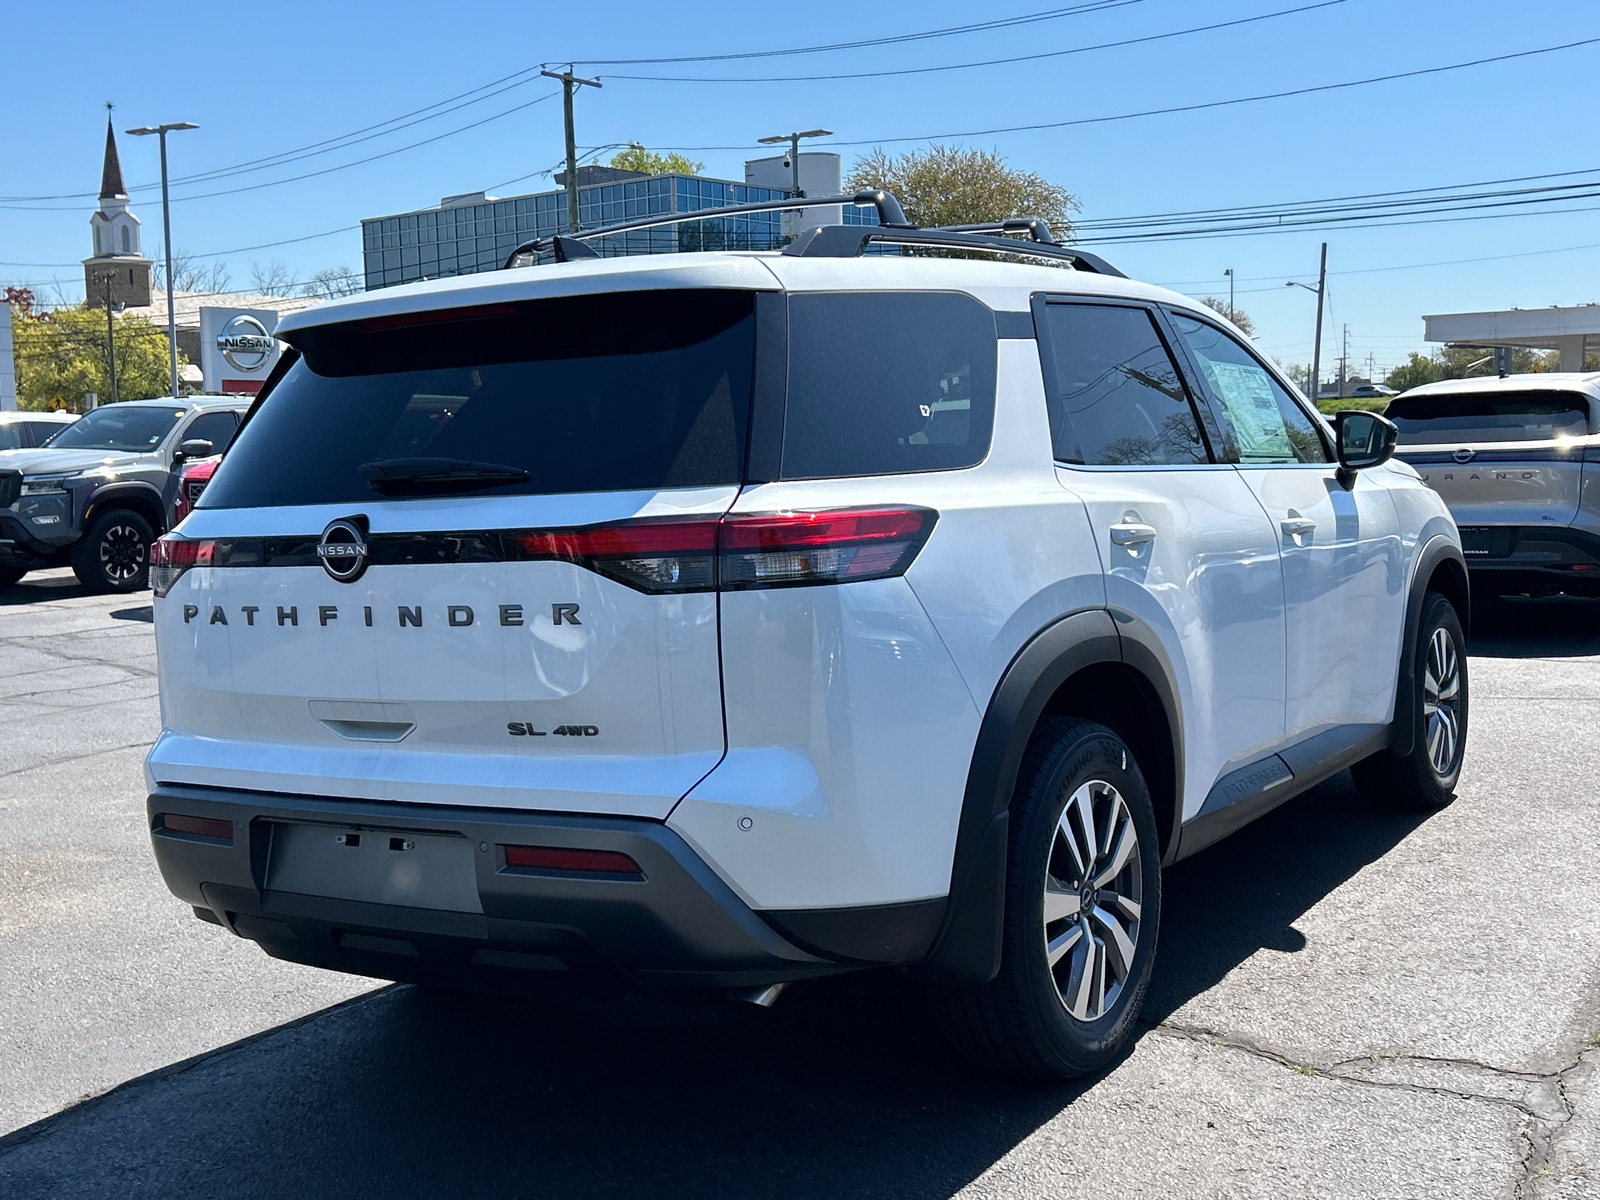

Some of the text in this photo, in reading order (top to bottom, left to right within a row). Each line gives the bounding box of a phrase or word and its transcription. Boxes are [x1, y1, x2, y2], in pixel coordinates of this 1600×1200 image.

[224, 337, 271, 349] NISSAN
[317, 545, 366, 556] NISSAN
[182, 602, 583, 628] PATHFINDER
[507, 722, 599, 736] SL 4WD
[1055, 750, 1094, 804] KUMHO
[1221, 763, 1287, 799] PATHFINDER
